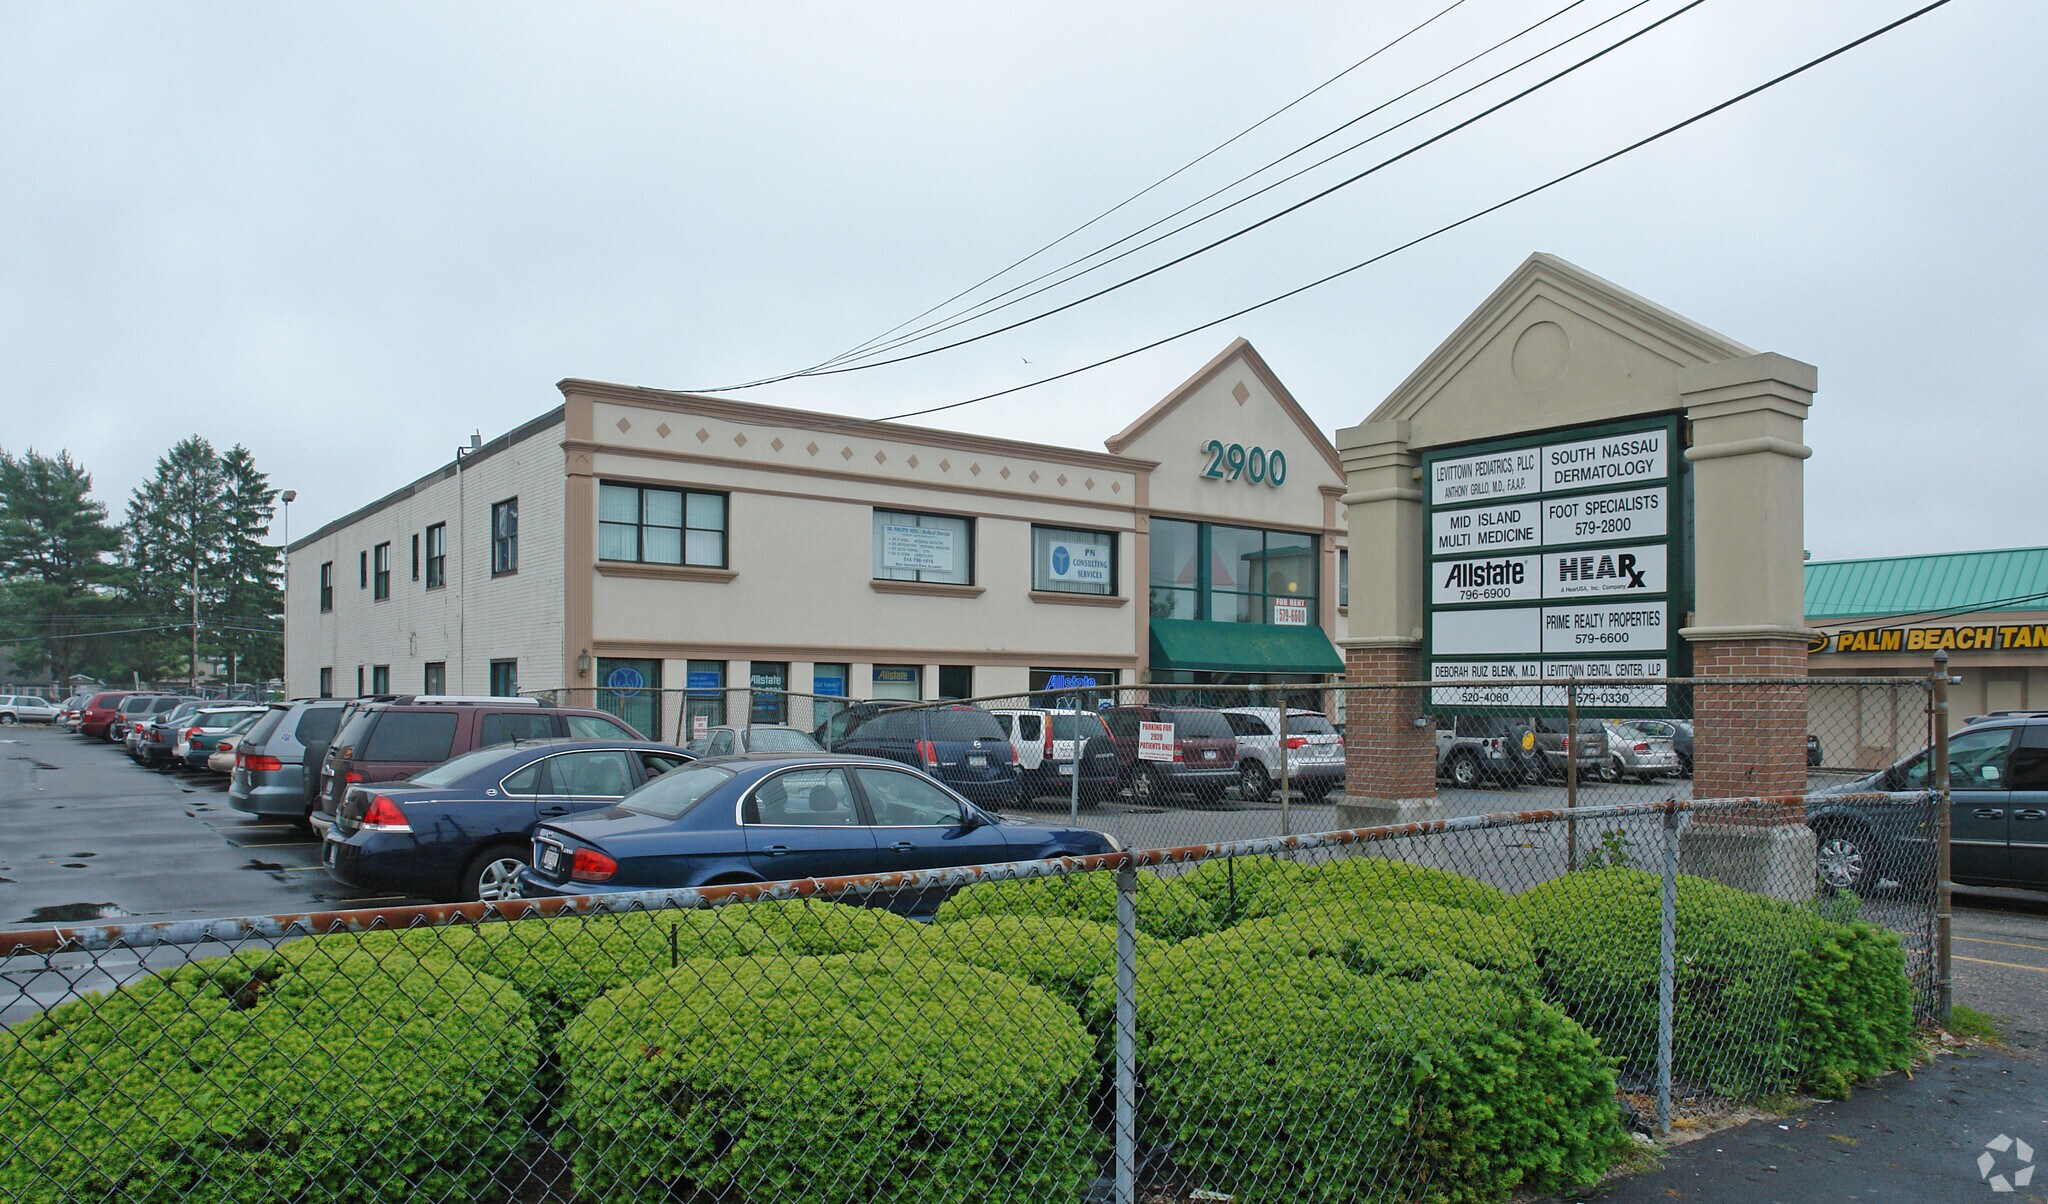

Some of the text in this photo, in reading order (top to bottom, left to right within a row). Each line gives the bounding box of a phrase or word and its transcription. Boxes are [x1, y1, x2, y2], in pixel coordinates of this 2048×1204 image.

[1551, 438, 1659, 465] SOUTH NASSAU
[1200, 439, 1287, 488] 2900
[1436, 454, 1535, 482] LEVITTOWN PEDIATRICS, PLLC
[1554, 459, 1654, 484] DERMATOLOGY
[1445, 485, 1469, 499] ANTHONY
[1470, 481, 1491, 496] GRILLO,
[1507, 477, 1526, 491] F.A.A.P.
[1549, 494, 1659, 519] FOOT SPECIALISTS
[1450, 510, 1521, 530] MID ISLAND
[1575, 517, 1632, 536] 579-2800
[1439, 527, 1534, 549] MULTI MEDICINE
[1084, 548, 1096, 557] PN
[1072, 558, 1108, 569] CONSULTING
[1077, 569, 1103, 579] SERVICES
[1444, 560, 1525, 589] Allstate
[1460, 587, 1511, 600] 796-6900
[1602, 583, 1626, 591] Company
[1276, 597, 1305, 607] FOR RENT
[1546, 610, 1661, 630] PRIME REALTY PROPERTIES
[1575, 632, 1630, 644] 579-6600
[1837, 624, 2048, 651] PALM BEACH TAN
[878, 670, 908, 680] Allstate
[1435, 664, 1538, 679] DEBORAH RUIZ BLENK, M.D.
[1547, 663, 1661, 678] LEVITTOWN DENTAL CENTER, LLP
[750, 674, 782, 685] Allstate
[1576, 693, 1629, 704] 579-0330
[1141, 723, 1162, 731] PARKING
[1139, 741, 1174, 751] PATIENTS ONLY
